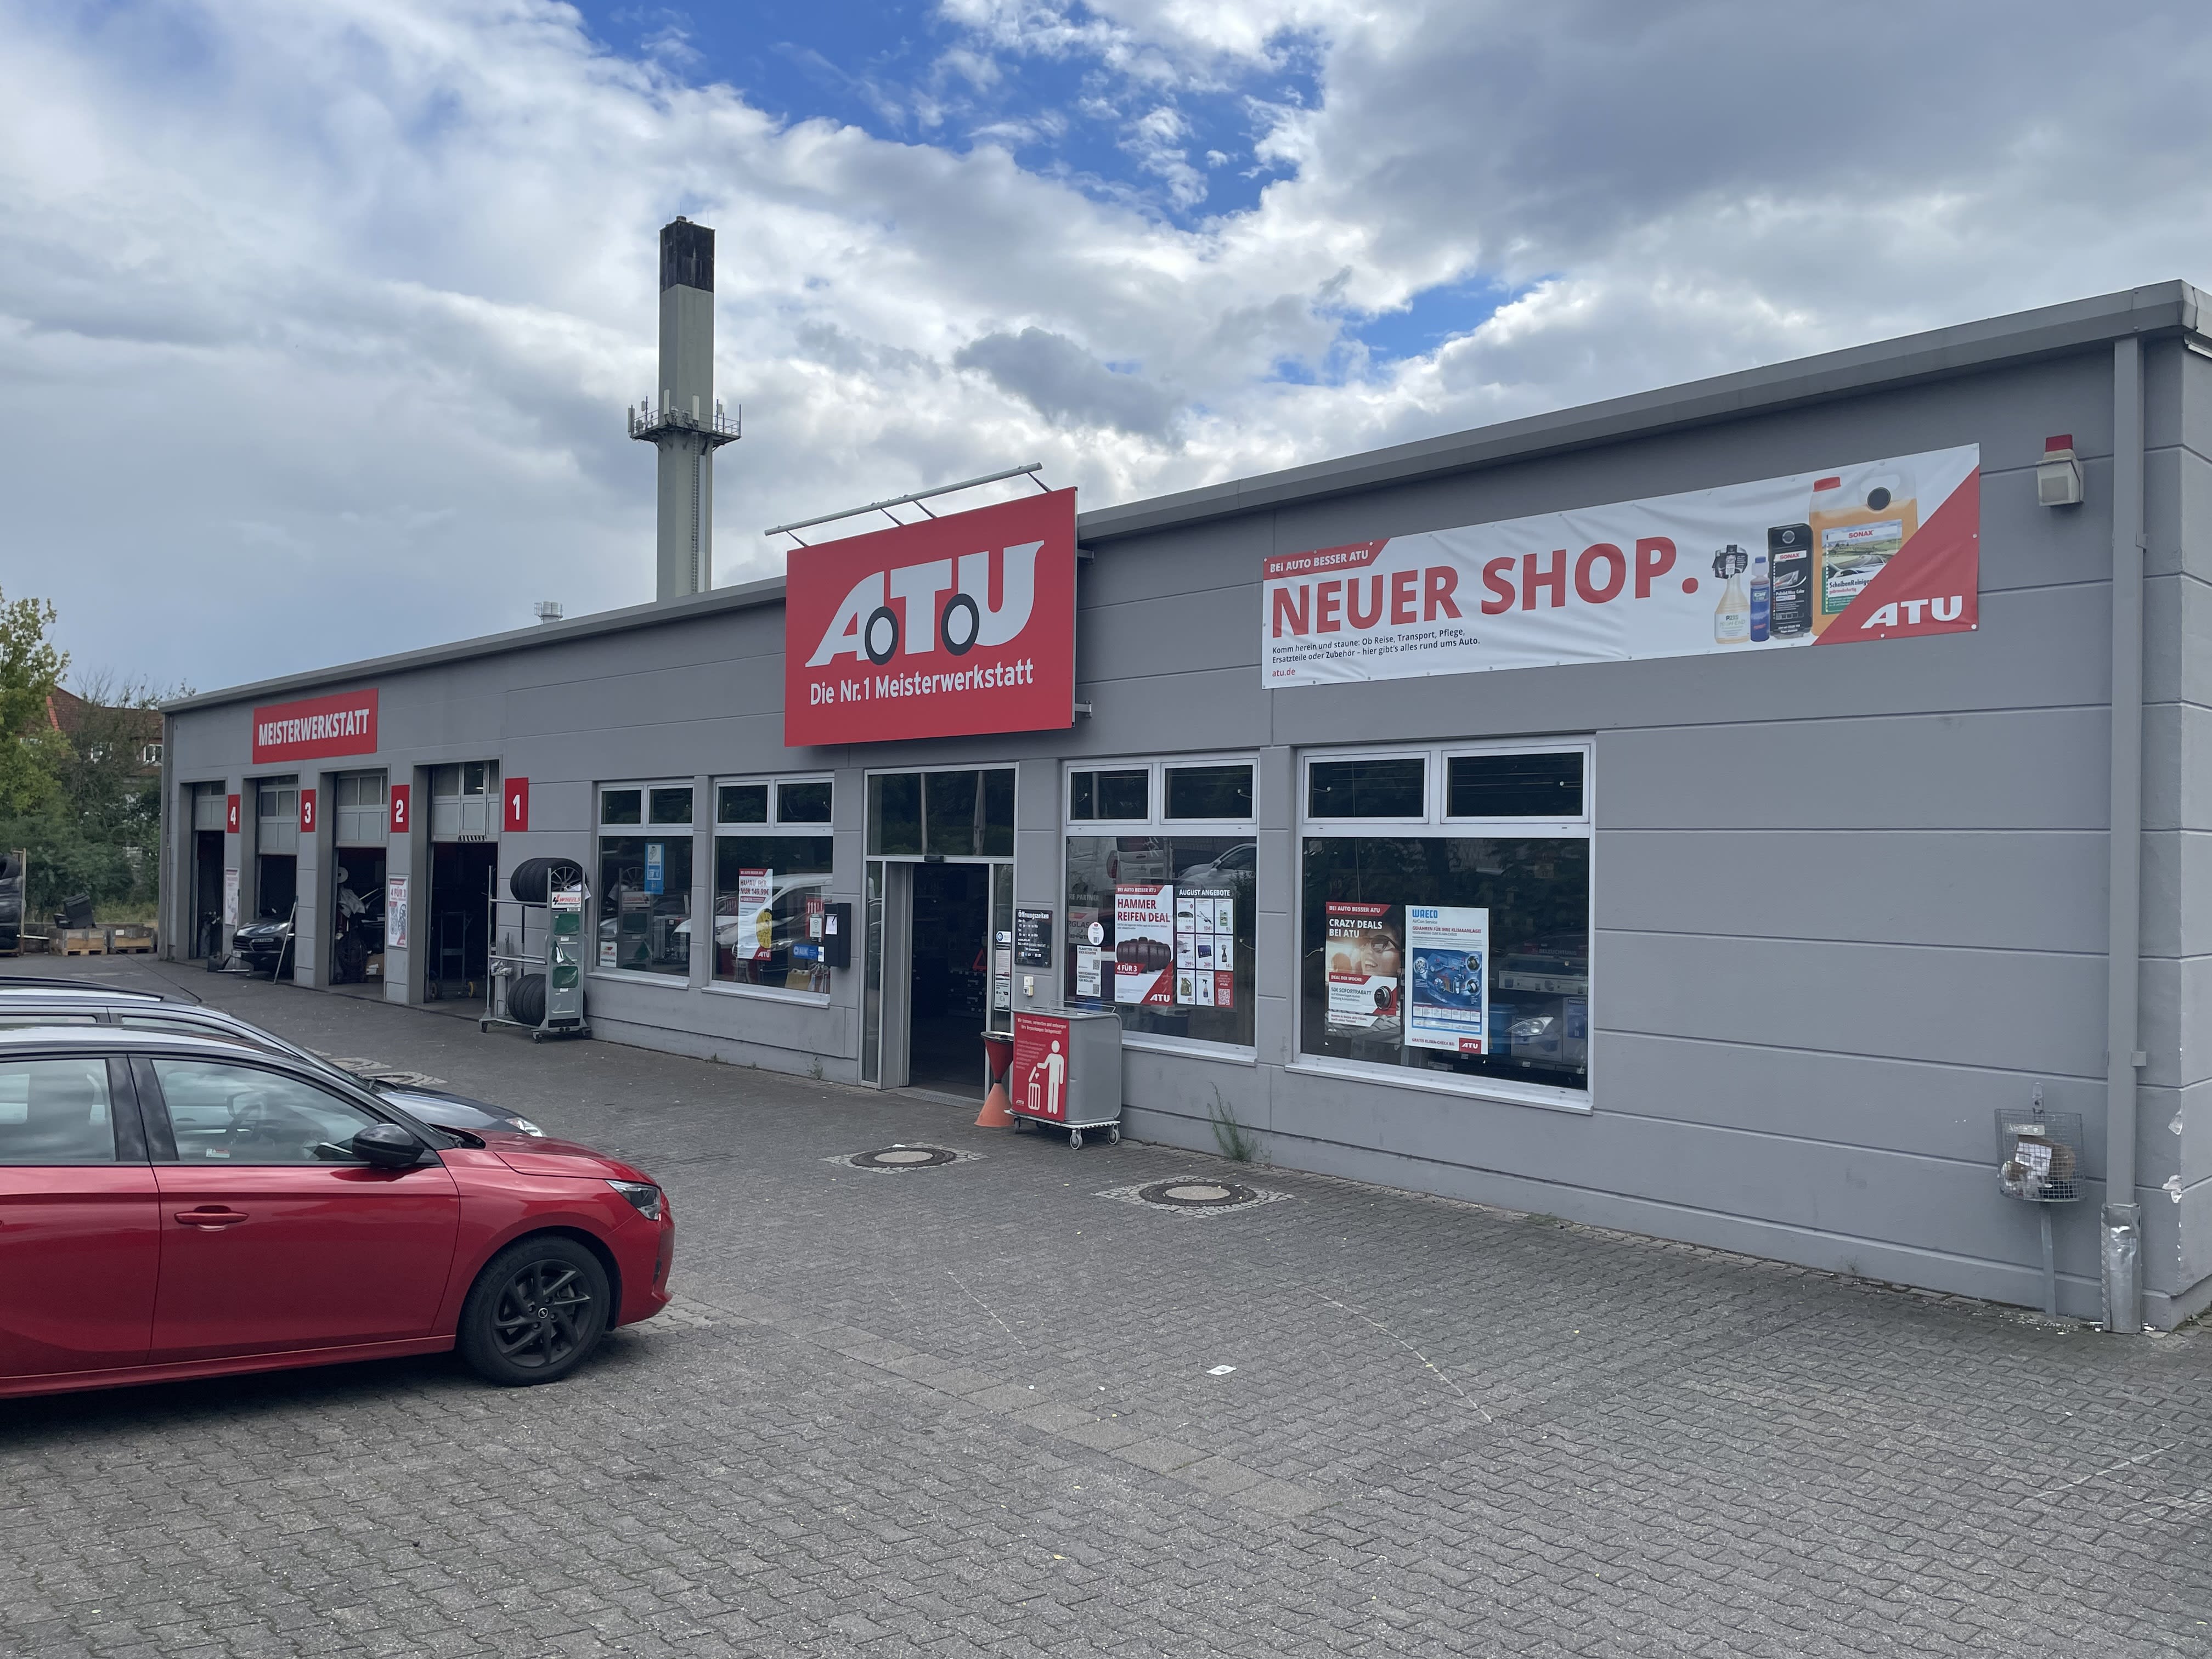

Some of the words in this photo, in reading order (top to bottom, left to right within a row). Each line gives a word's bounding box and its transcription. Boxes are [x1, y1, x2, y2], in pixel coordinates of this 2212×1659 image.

[1848, 530, 1874, 538] SONAX
[1270, 564, 1283, 573] BEI
[1286, 558, 1311, 571] AUTO
[1313, 553, 1347, 566] BESSER
[1349, 550, 1368, 562] ATU
[1273, 566, 1463, 638] NEUER
[1481, 536, 1699, 615] SHOP.
[1861, 595, 1962, 629] ATU
[1295, 643, 1317, 653] herein
[1319, 641, 1332, 650] und
[1334, 639, 1360, 648] staune:
[1362, 637, 1372, 646] Ob
[1374, 635, 1396, 645] Reise,
[1397, 631, 1437, 643] Transport,
[1439, 628, 1465, 639] Pflege,
[1272, 653, 1307, 664] Ersatzteile
[1308, 651, 1324, 660] oder
[1326, 649, 1355, 659] Zubehör
[1362, 646, 1376, 656] hier
[1401, 642, 1417, 652] alles
[1419, 640, 1438, 650] rund
[1459, 637, 1480, 646] Auto.
[810, 682, 834, 706] Die
[876, 658, 1034, 699] Meisterwerkstatt
[1272, 668, 1295, 678] atu.de
[258, 708, 369, 746] MEISTERWERKSTATT
[230, 806, 236, 825] 4
[304, 802, 311, 823] 3
[396, 799, 404, 823] 2
[512, 794, 520, 820] 1
[1118, 899, 1156, 909] HAMMER
[1412, 909, 1437, 918] WAECO
[1018, 910, 1049, 919] Öffnungszeiten
[1118, 911, 1146, 922] REIFEN
[1148, 912, 1171, 923] DEAL
[1329, 918, 1355, 928] CRAZY
[1357, 920, 1383, 929] DEALS
[1329, 928, 1341, 937] BEI
[1344, 929, 1359, 938] ATU
[1121, 963, 1132, 972] FÜR
[1150, 994, 1170, 1002] ATU
